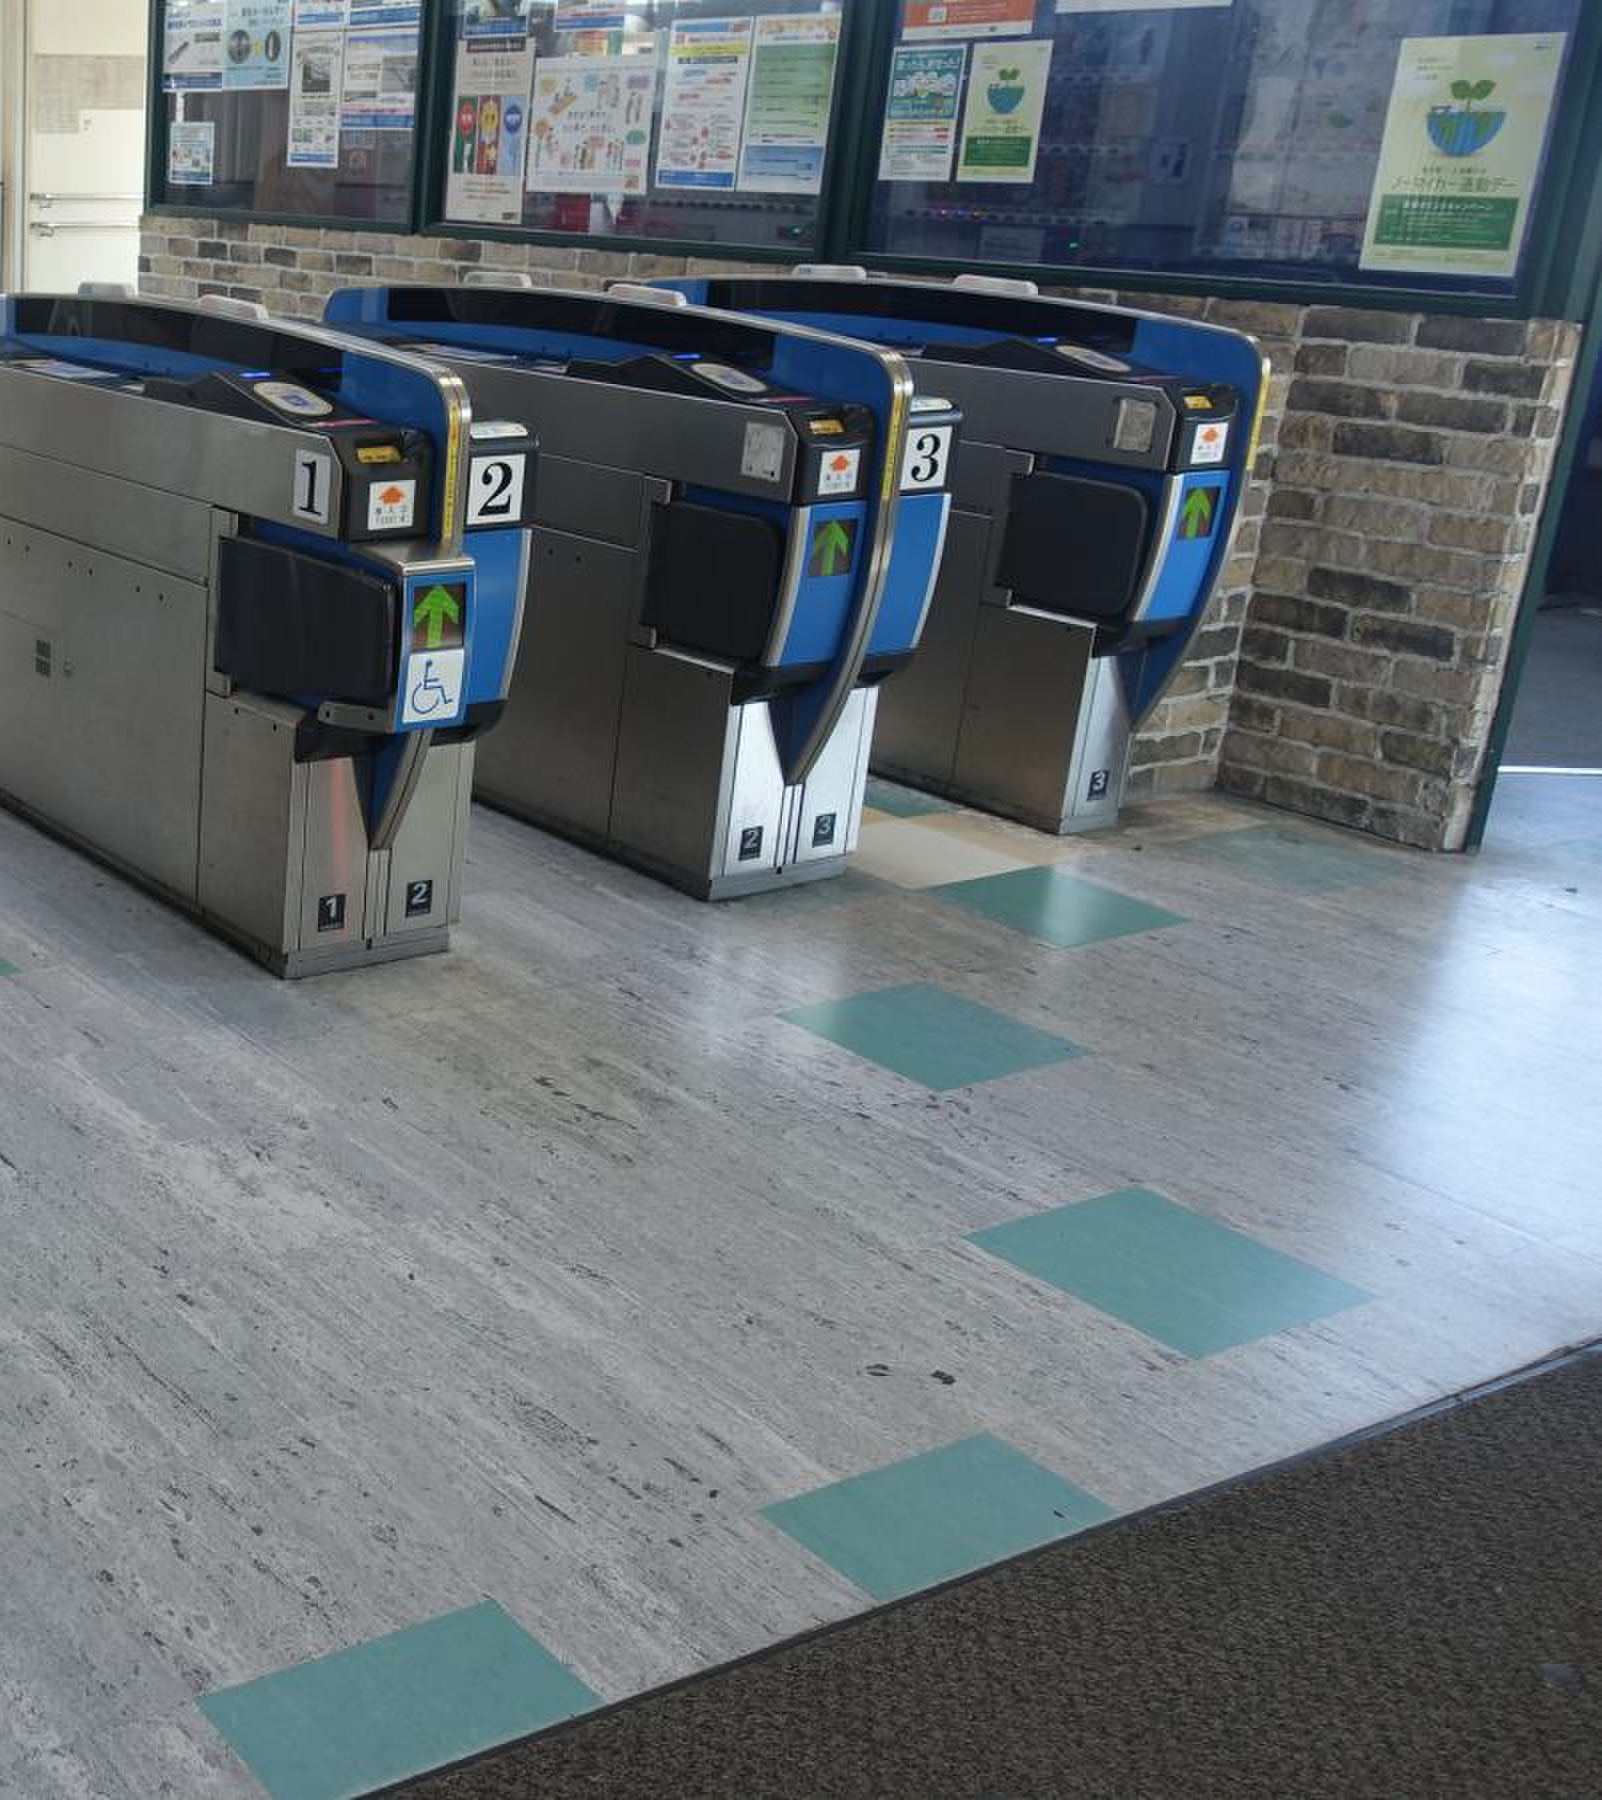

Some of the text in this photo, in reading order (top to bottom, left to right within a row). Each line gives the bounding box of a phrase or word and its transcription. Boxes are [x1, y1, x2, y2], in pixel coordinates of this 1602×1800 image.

[911, 433, 941, 482] 3
[301, 459, 322, 516] 1
[478, 461, 512, 517] 2
[1093, 771, 1105, 791] 3
[818, 815, 832, 835] 3
[743, 830, 758, 849] 2
[411, 882, 428, 905] 2
[325, 897, 338, 919] 1
